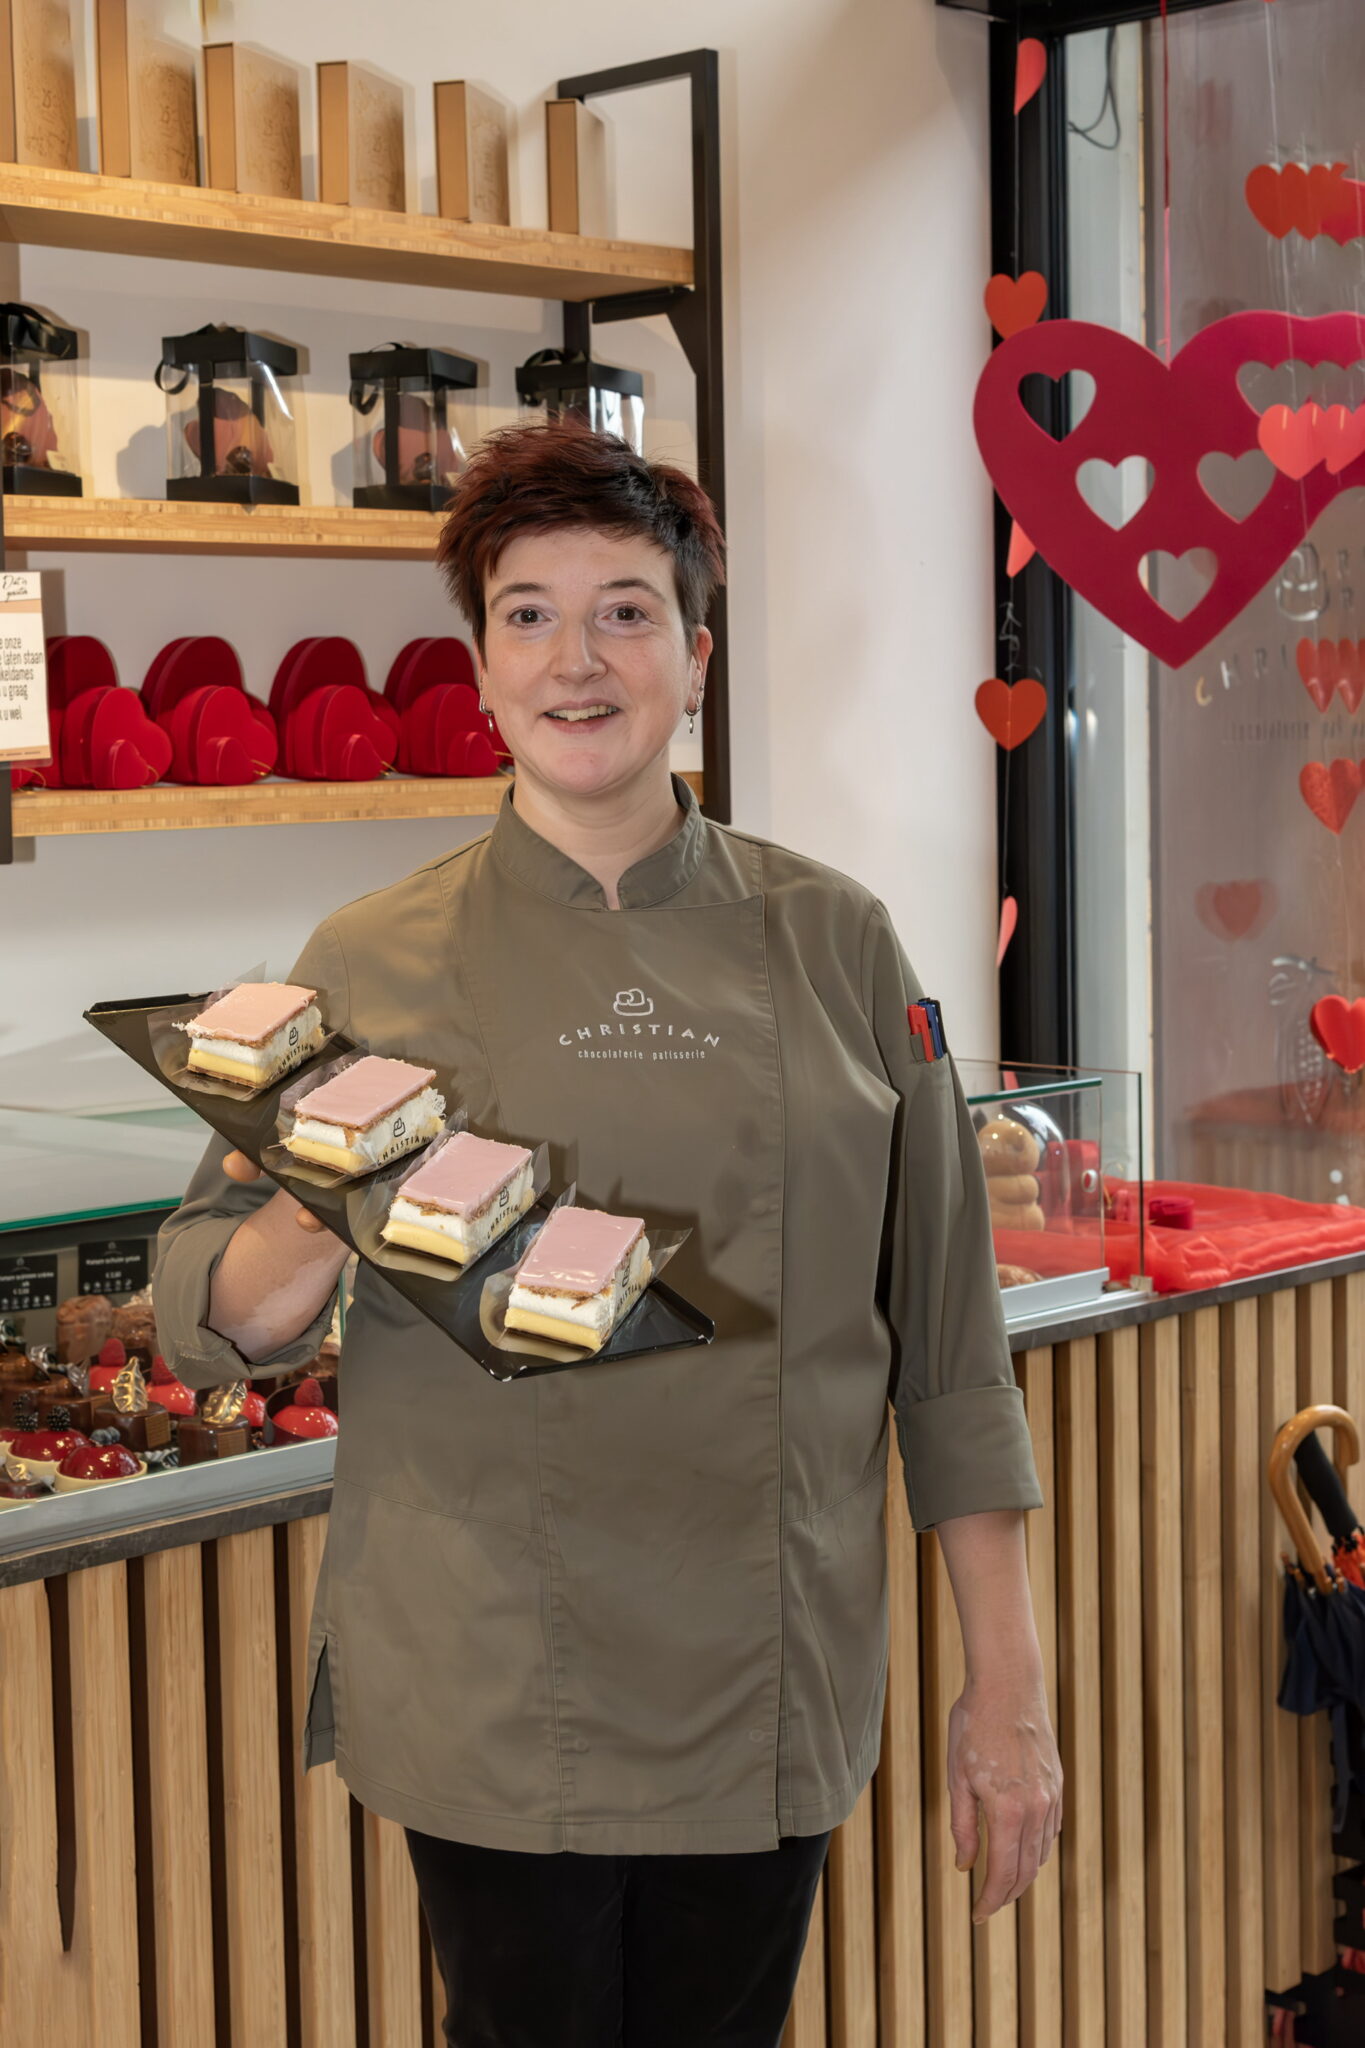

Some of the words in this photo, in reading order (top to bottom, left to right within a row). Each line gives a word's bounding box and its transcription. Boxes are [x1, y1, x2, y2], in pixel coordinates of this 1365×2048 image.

[23, 649, 44, 664] staan
[559, 1023, 720, 1048] CHRISTIAN
[578, 1049, 644, 1060] chocolaterie
[652, 1050, 706, 1061] patisserie
